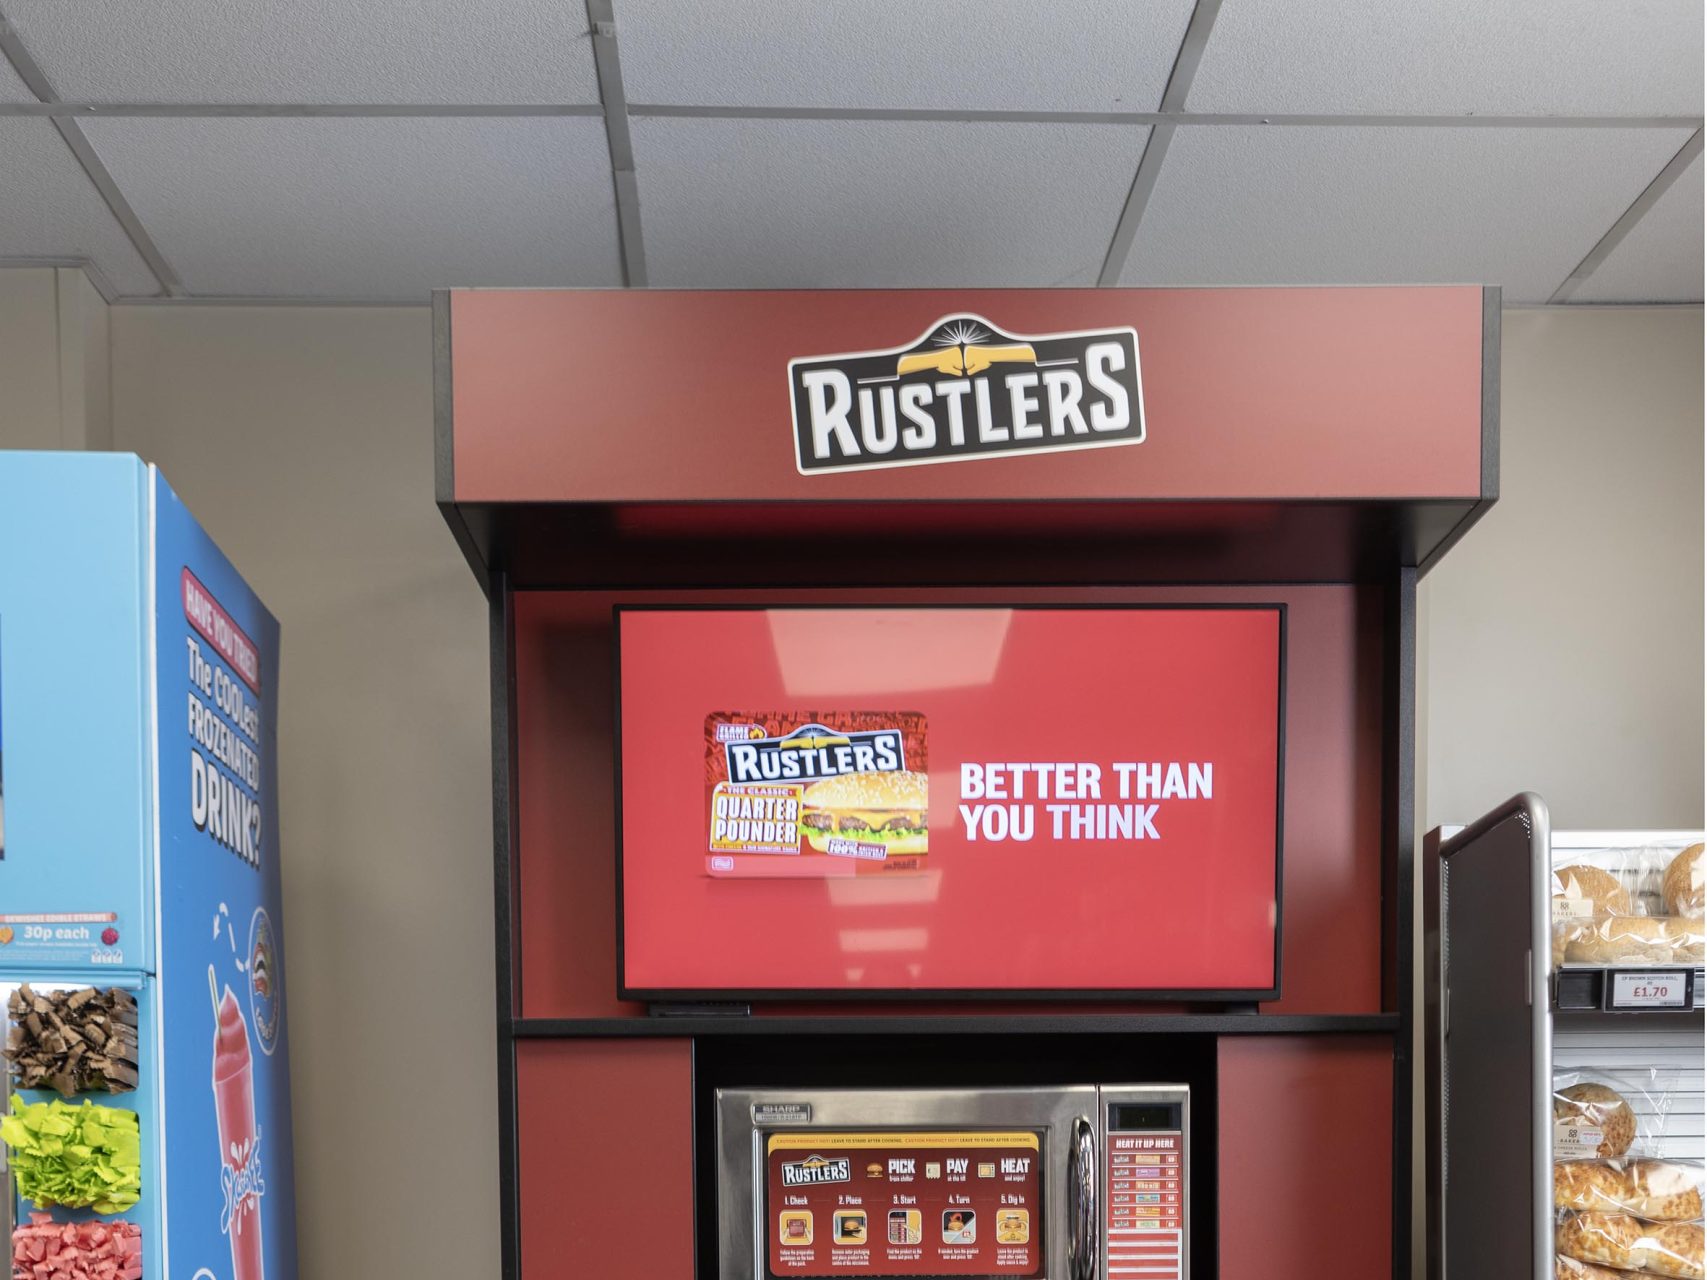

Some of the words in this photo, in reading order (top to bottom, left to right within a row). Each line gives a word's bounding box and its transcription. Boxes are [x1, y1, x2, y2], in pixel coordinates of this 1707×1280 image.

[802, 342, 1130, 459] RUSTLERS
[185, 578, 213, 634] HAVE
[211, 607, 233, 654] YOU
[188, 636, 211, 696] The
[188, 691, 259, 793] FROZENATED
[732, 736, 898, 781] RUSTLERS
[960, 762, 1102, 799] BETTER
[1113, 762, 1213, 799] THAN
[747, 788, 788, 796] CLASSIC
[191, 748, 261, 868] DRINK?
[717, 796, 798, 821] QUARTER
[959, 804, 1034, 841] YOU
[1046, 805, 1160, 839] THINK
[715, 819, 796, 843] POUNDER
[24, 926, 52, 941] 30p
[55, 926, 90, 939] each
[1633, 987, 1668, 997] £1.70
[763, 1105, 800, 1113] SHARP
[1116, 1138, 1135, 1148] HEAT
[1135, 1138, 1143, 1148] IT
[1143, 1138, 1154, 1148] UP
[1155, 1138, 1174, 1148] HERE
[784, 1161, 848, 1184] RUSTLERS
[888, 1158, 916, 1174] PICK
[946, 1158, 969, 1174] PAY
[1001, 1157, 1030, 1174] HEAT
[790, 1195, 808, 1205] Check
[845, 1195, 862, 1205] Place
[893, 1194, 899, 1204] 3.
[900, 1194, 916, 1205] Start
[948, 1194, 955, 1204] 4.
[956, 1194, 970, 1204] Turn
[1008, 1194, 1018, 1206] Dig
